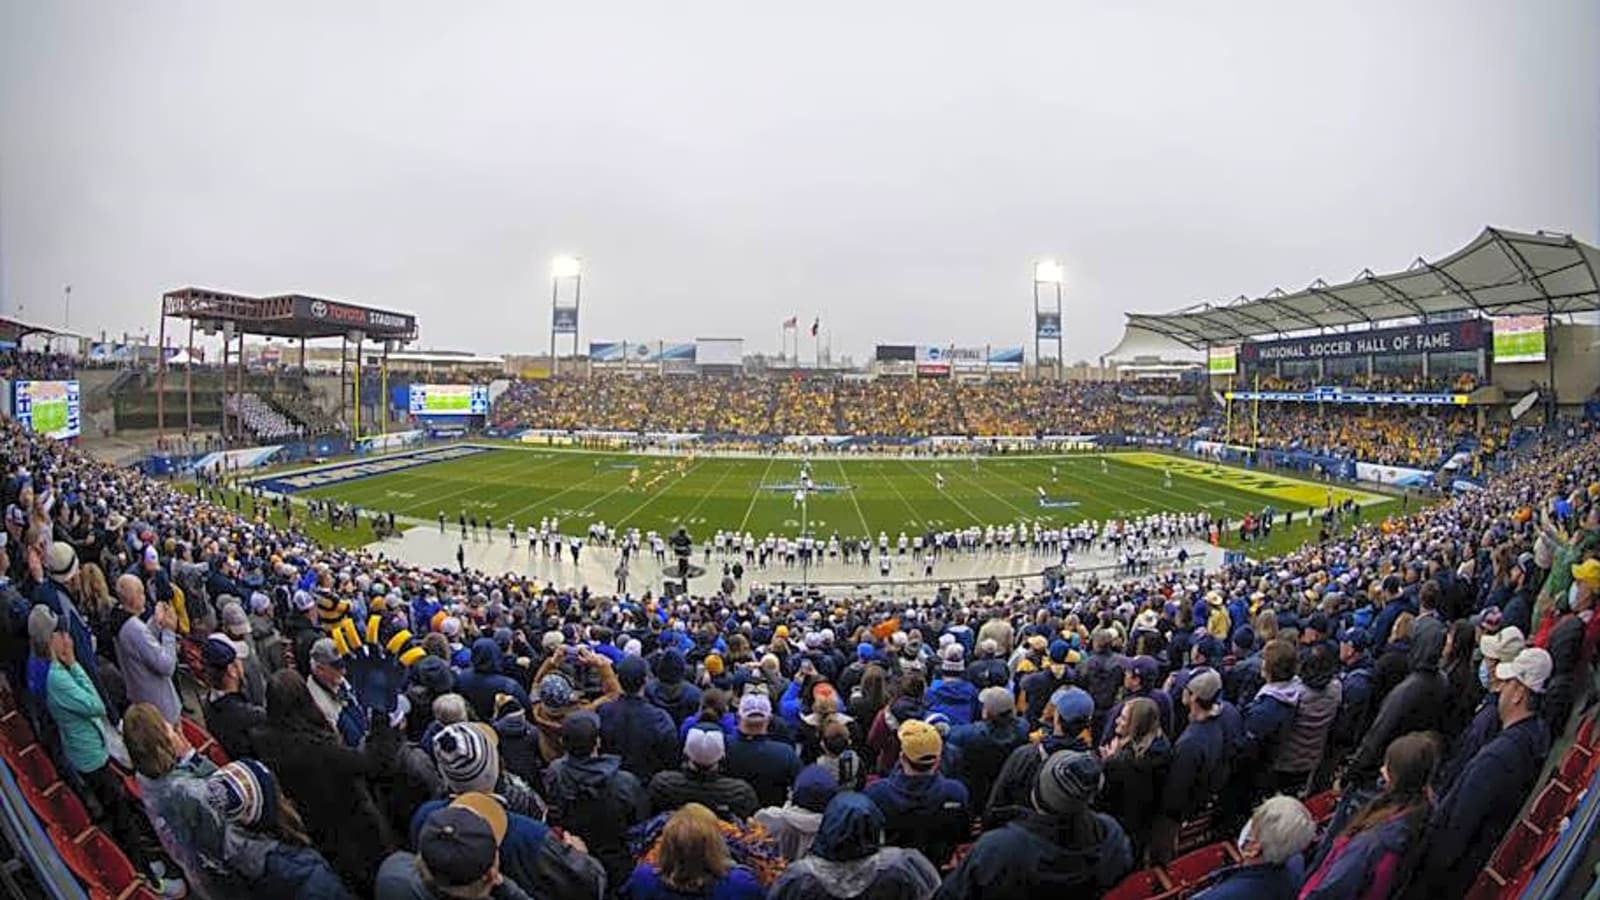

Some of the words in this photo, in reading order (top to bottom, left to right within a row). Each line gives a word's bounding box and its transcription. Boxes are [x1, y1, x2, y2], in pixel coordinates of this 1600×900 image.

[329, 304, 366, 321] TOYOTA
[369, 311, 406, 327] STADIUM
[1260, 344, 1305, 358] NATIONAL
[1309, 340, 1352, 356] SOCCER
[1356, 338, 1387, 352] HALL
[1392, 336, 1410, 350] OF
[1416, 332, 1451, 349] FAME
